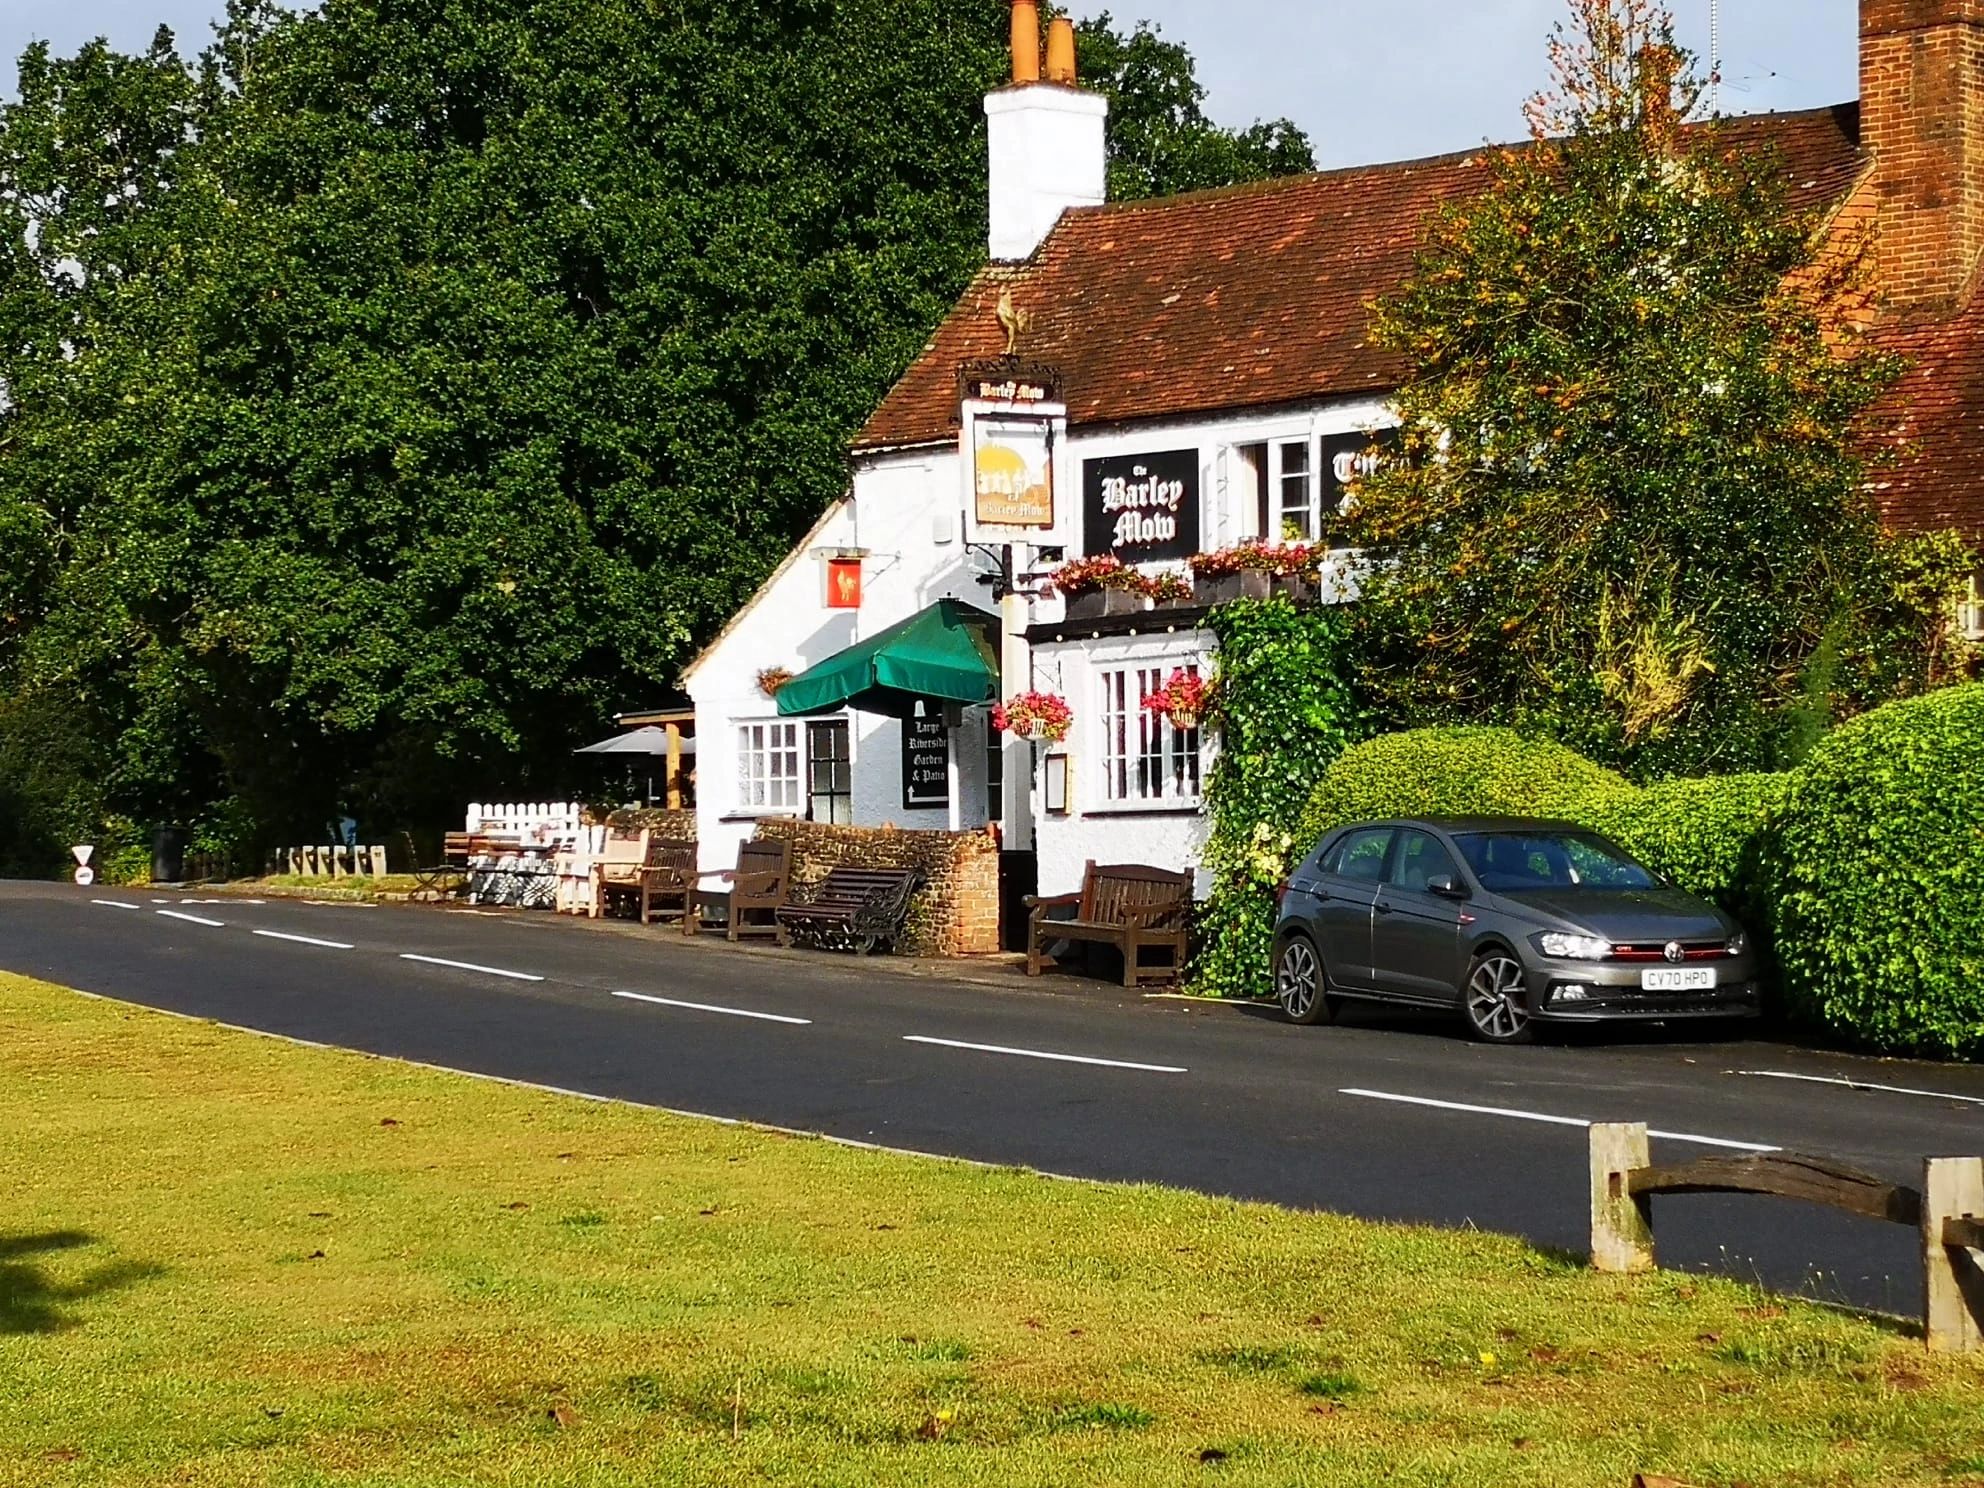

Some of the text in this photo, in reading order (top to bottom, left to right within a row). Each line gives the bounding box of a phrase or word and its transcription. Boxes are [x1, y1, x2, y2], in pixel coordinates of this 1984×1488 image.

[979, 382, 1044, 400] Barley Mow
[1101, 474, 1184, 513] Barley
[1111, 510, 1176, 547] Mow
[914, 721, 940, 735] Large
[908, 737, 947, 750] Riverside
[913, 754, 944, 766] Garden
[911, 769, 946, 784] & Patio
[1648, 971, 1708, 986] CV70 HPO
